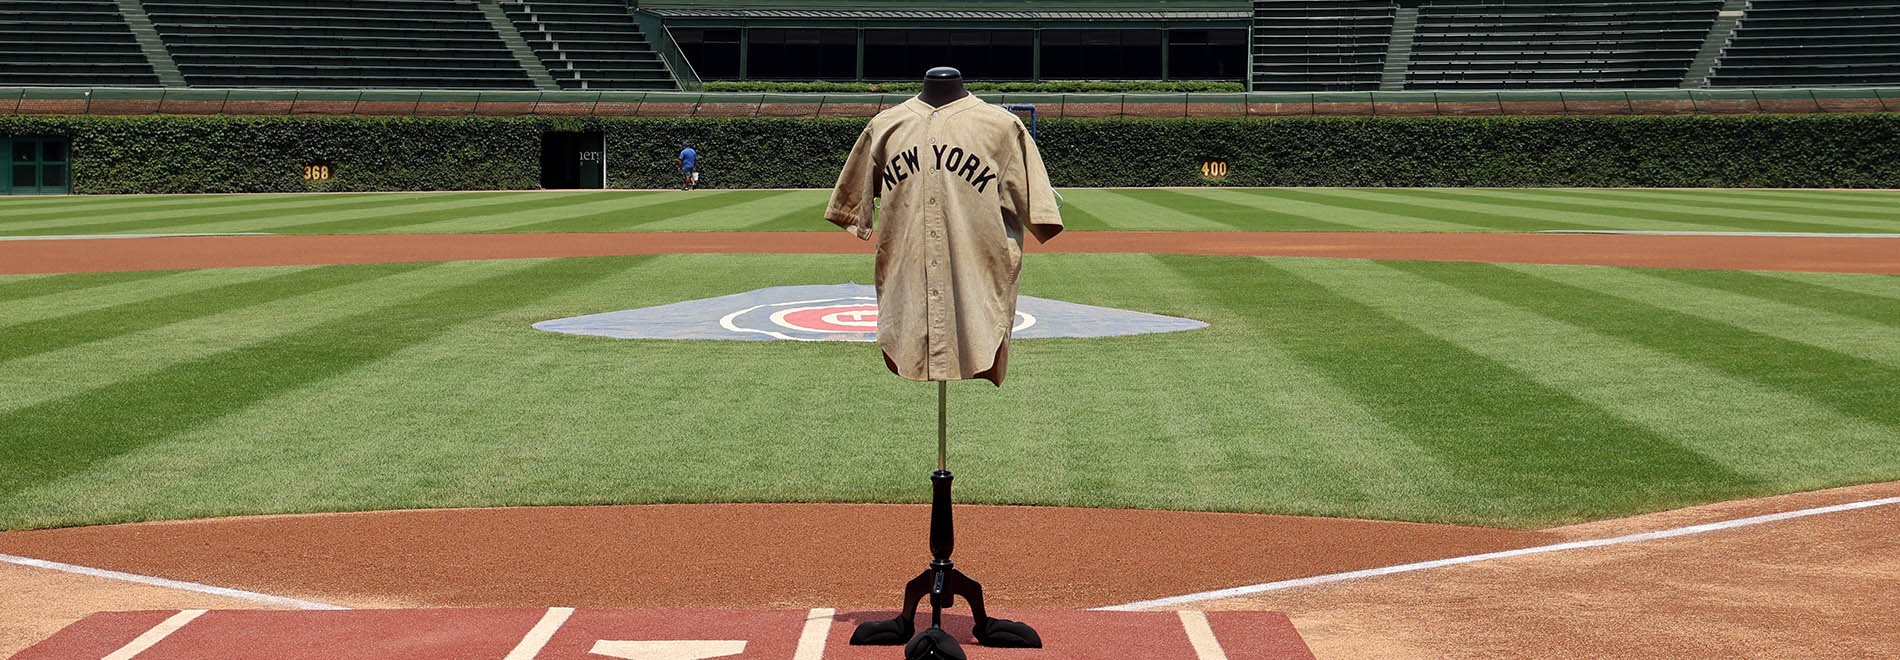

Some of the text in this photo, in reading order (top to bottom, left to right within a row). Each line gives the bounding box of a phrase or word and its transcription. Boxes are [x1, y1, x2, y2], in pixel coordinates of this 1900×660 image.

[303, 165, 329, 180] 368
[883, 144, 997, 194] NEW YORK
[1201, 161, 1227, 177] 400
